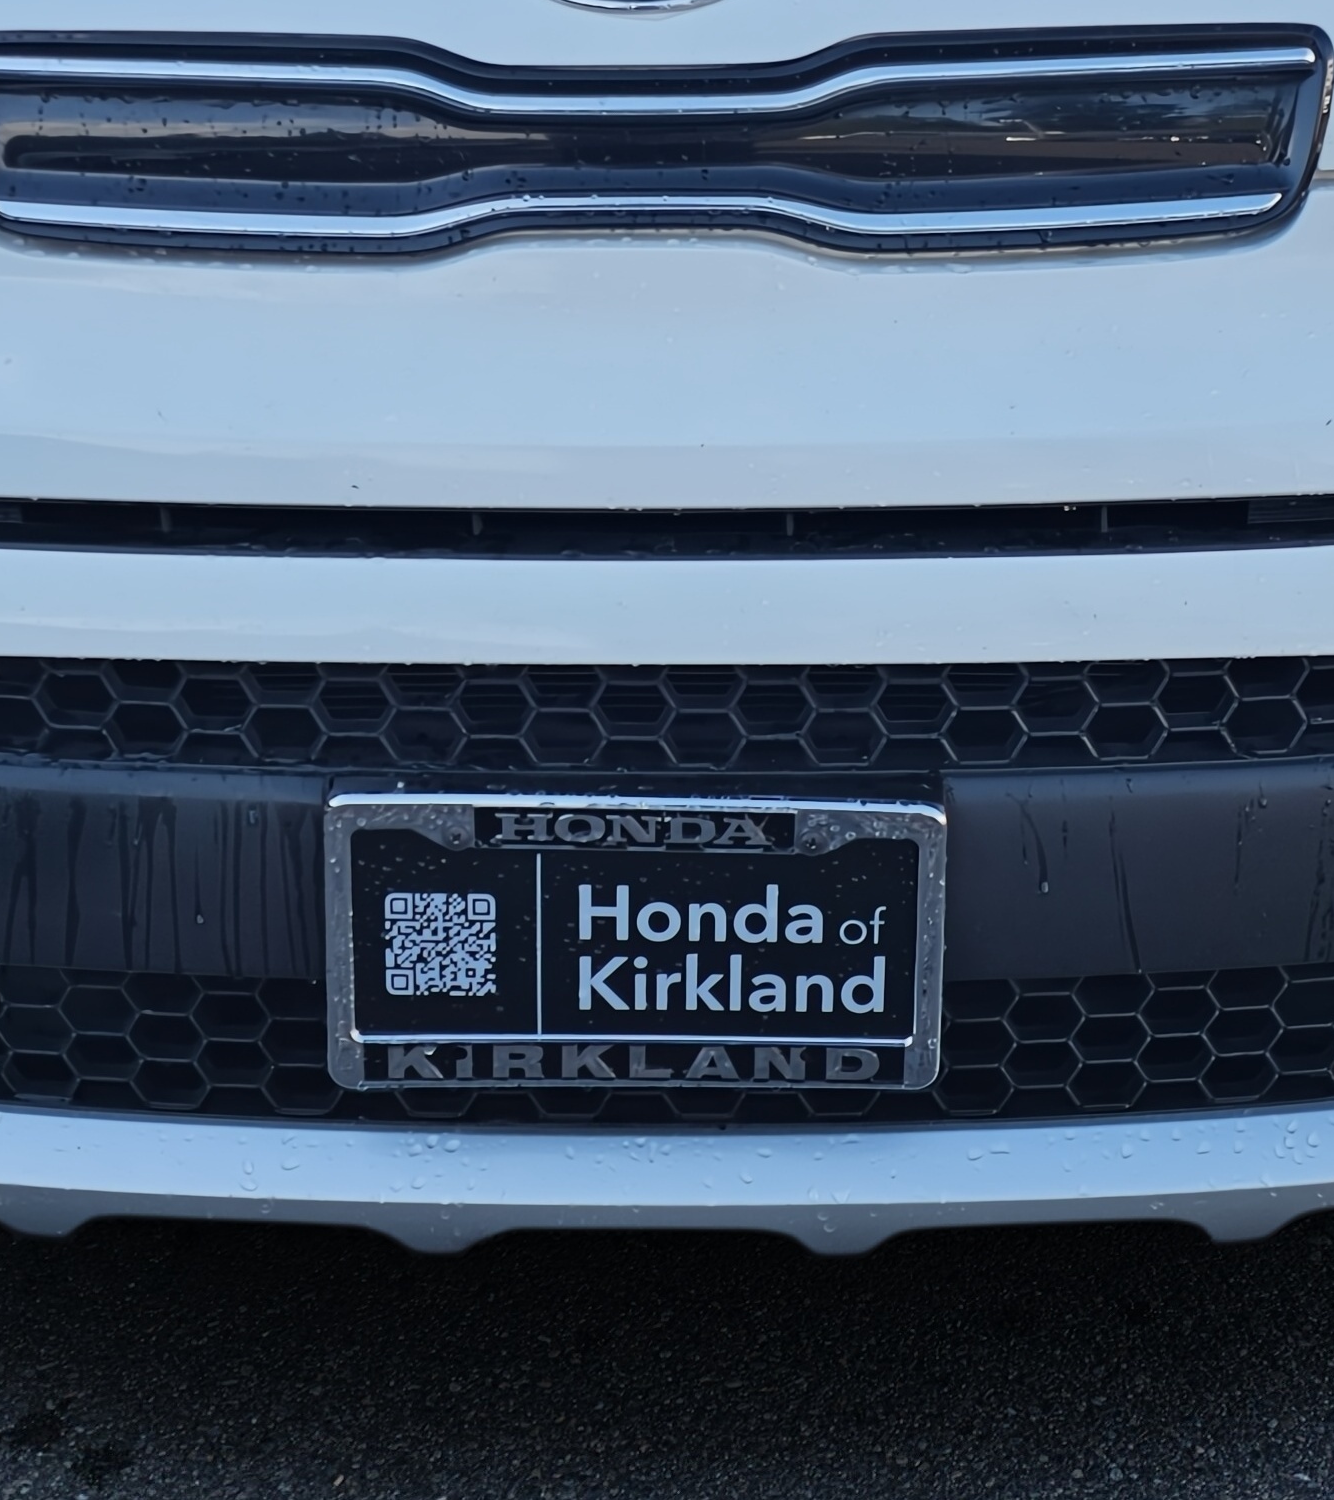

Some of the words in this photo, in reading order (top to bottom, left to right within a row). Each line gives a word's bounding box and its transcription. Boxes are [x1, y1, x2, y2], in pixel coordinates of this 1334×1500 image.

[494, 812, 773, 846] HONDA
[578, 884, 823, 943] Honda
[839, 906, 887, 945] of
[578, 953, 886, 1013] Kirkland
[387, 1044, 881, 1080] KIRKLAND
